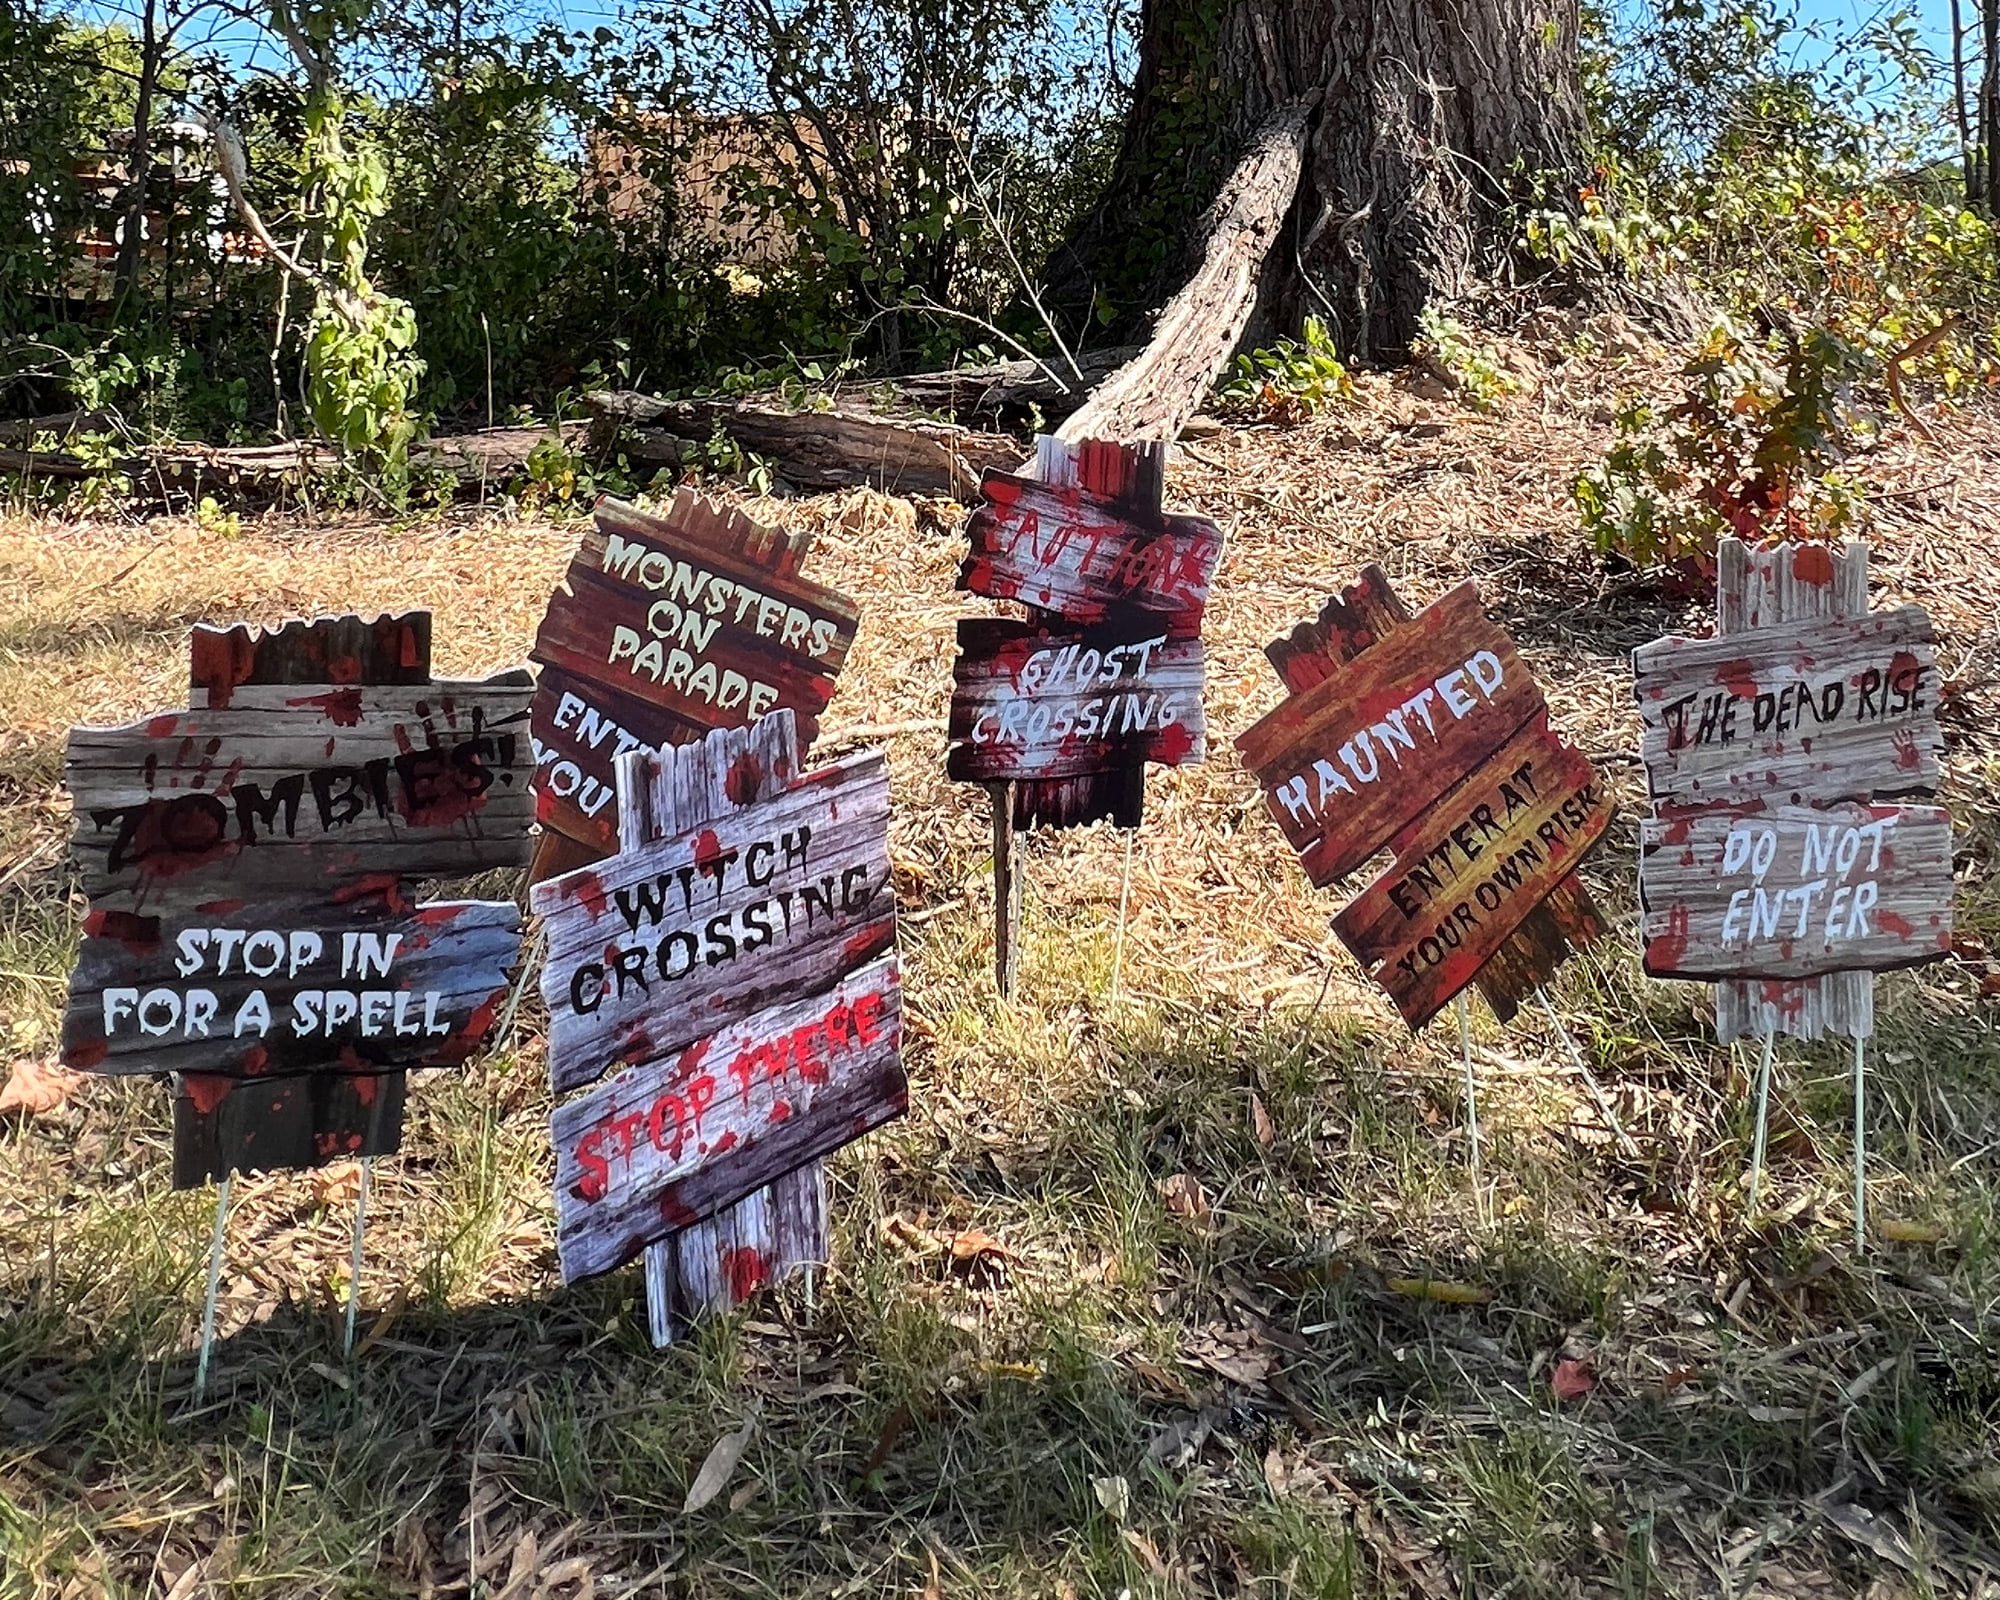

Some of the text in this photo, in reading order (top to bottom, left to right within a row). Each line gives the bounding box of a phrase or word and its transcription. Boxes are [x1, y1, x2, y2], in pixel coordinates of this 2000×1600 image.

[602, 534, 838, 657] MONSTERS
[647, 600, 721, 652] ON
[608, 626, 779, 720] PARADE
[1022, 634, 1168, 692] GHOST
[1662, 665, 1931, 749] THE DEAD RISE
[971, 692, 1187, 744] CROSSING
[1275, 649, 1508, 828] HAUNTED
[90, 735, 517, 875] ZOMBIES!
[1387, 761, 1543, 920] ENTER AT
[1721, 813, 1901, 886] DO NOT
[614, 825, 812, 940] WITCH
[1397, 784, 1603, 979] YOUR OWN RISK
[1721, 879, 1879, 950] ENTER
[174, 928, 403, 981] STOP IN
[570, 864, 872, 1017] CROSSING
[102, 988, 450, 1038] FOR A SPELL
[573, 992, 884, 1203] STOP THERE
